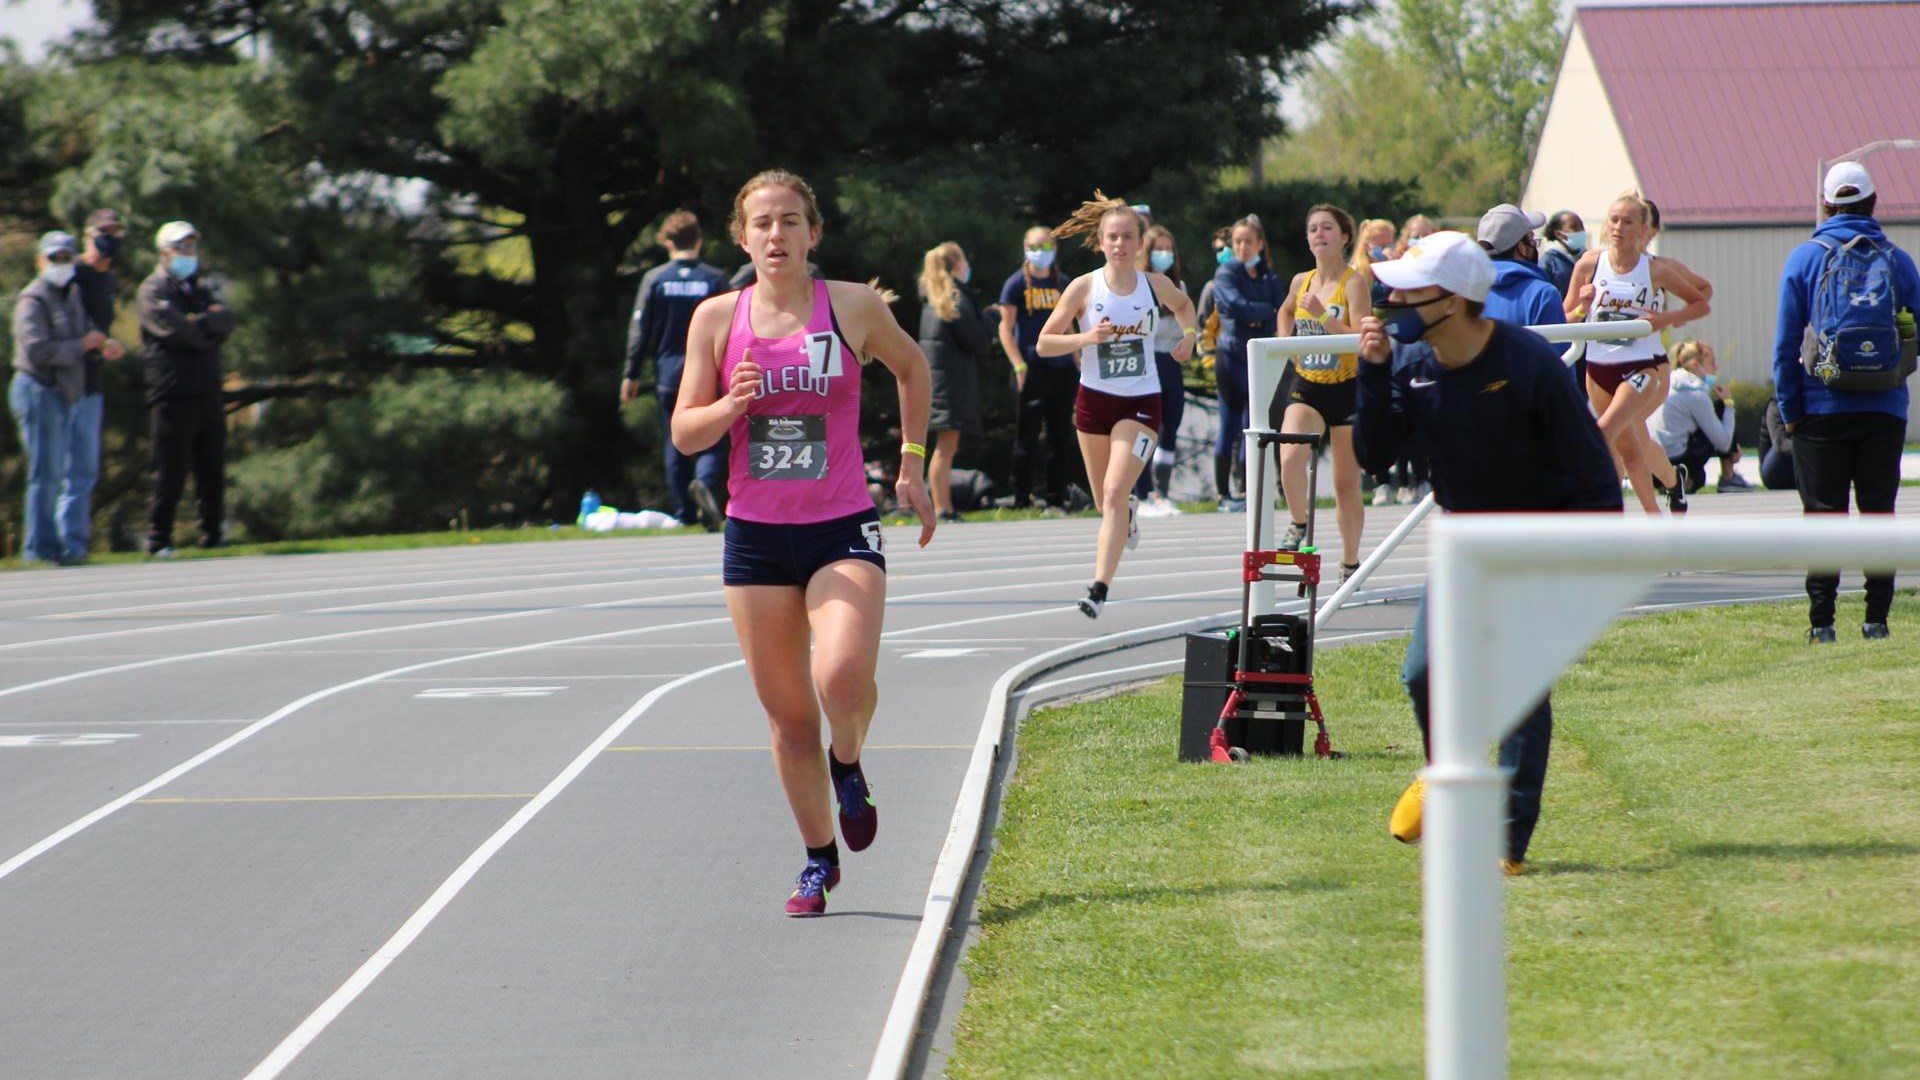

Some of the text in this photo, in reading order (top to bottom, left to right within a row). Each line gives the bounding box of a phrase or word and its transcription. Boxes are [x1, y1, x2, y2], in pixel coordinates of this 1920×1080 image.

[1597, 290, 1633, 313] Loyo
[1635, 287, 1647, 308] 4
[1146, 308, 1155, 332] 1
[813, 334, 833, 375] 7
[1107, 356, 1138, 374] 178
[753, 365, 829, 400] OLEDO
[759, 445, 813, 470] 324
[1141, 438, 1149, 458] 1
